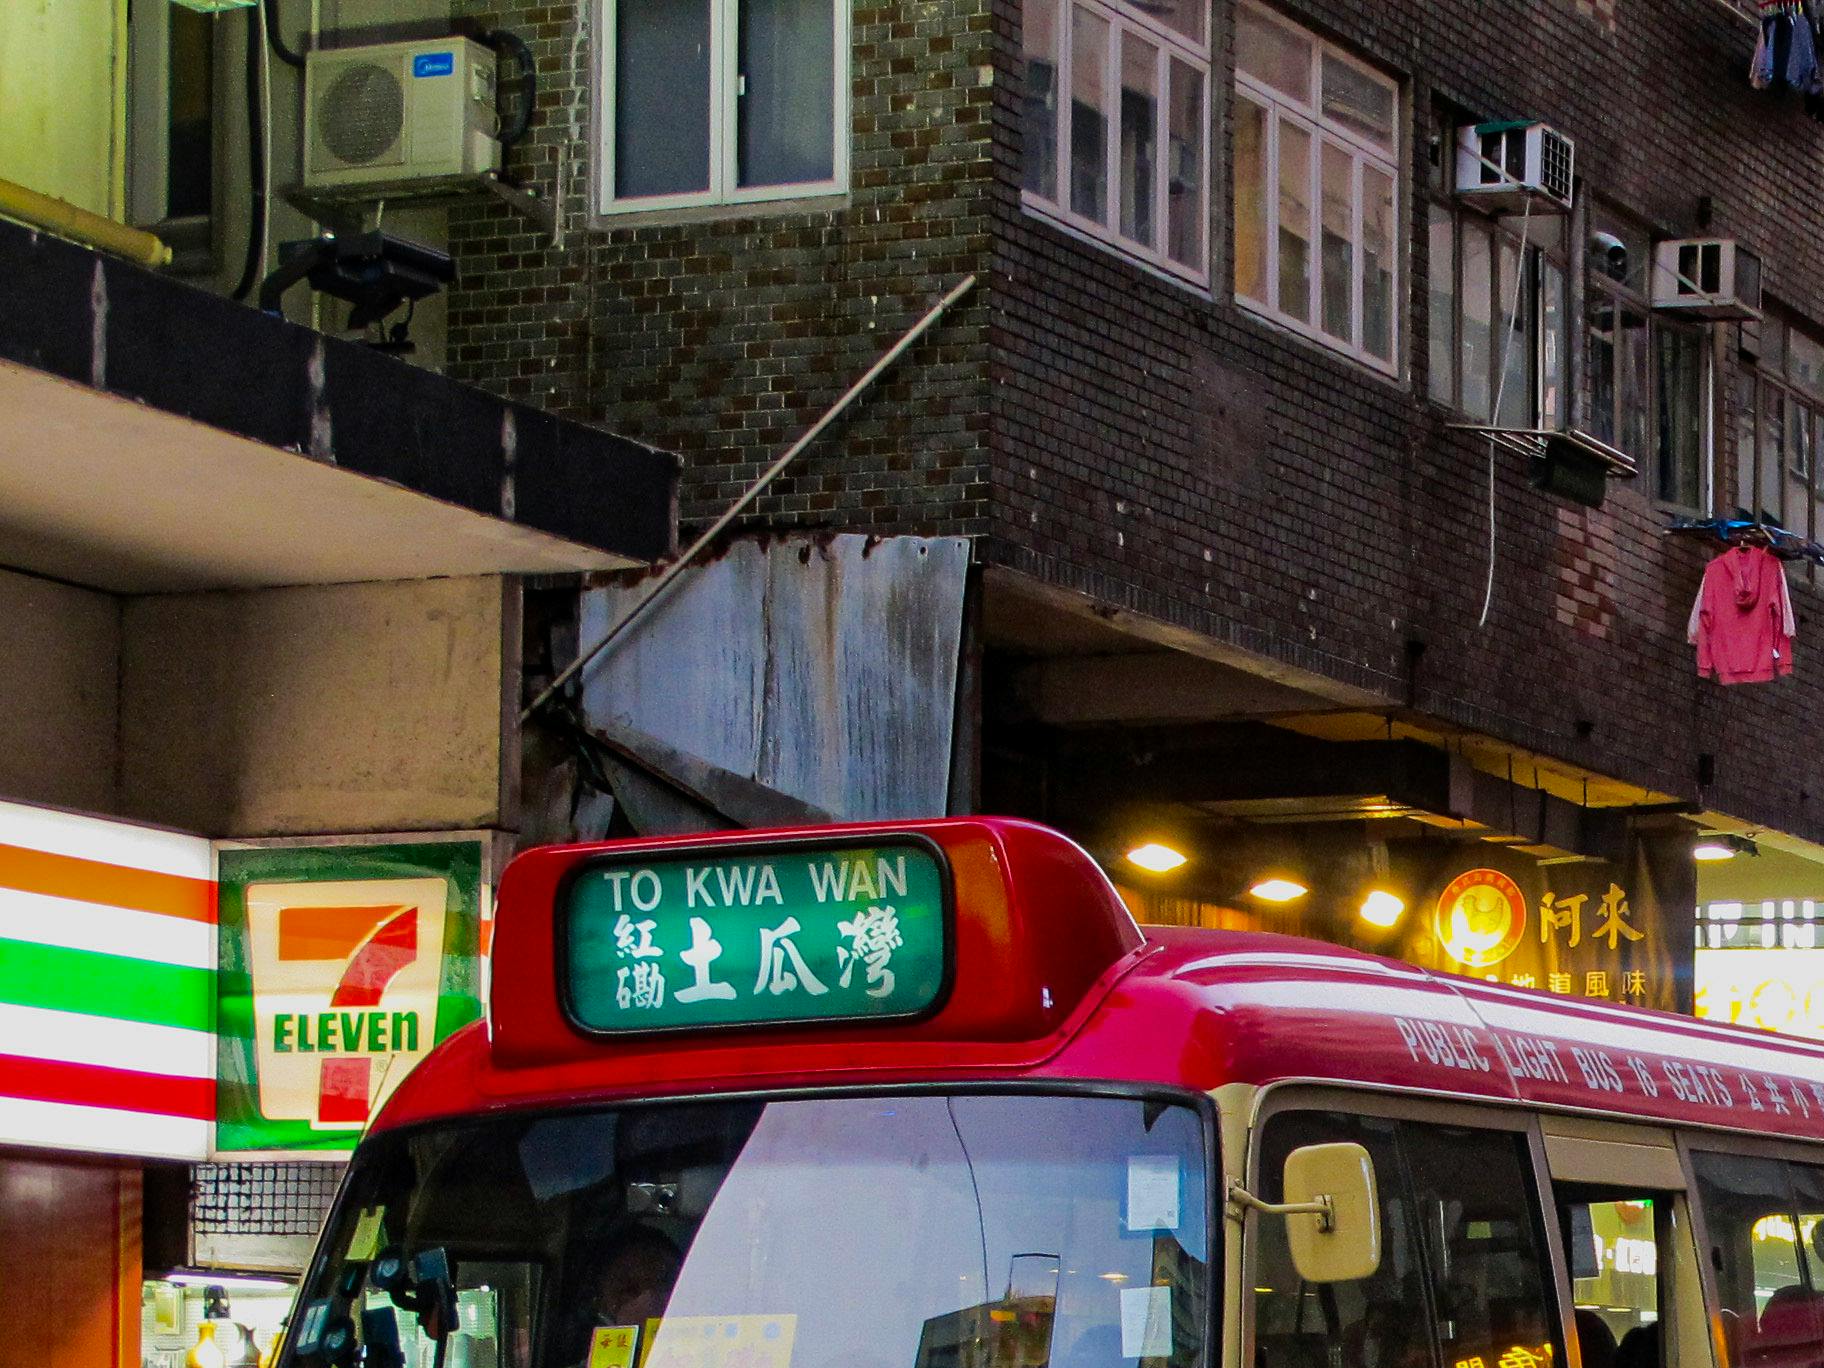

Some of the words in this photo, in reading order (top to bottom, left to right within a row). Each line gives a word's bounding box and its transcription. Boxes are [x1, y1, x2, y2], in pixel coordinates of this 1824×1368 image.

[604, 869, 663, 912] TO
[686, 864, 784, 908] KWA
[808, 856, 908, 903] WAN
[613, 913, 665, 1010] 紅磡
[673, 904, 904, 1004] 土瓜灣
[1485, 969, 1647, 997] 地道風味
[278, 904, 419, 1123] 7
[1394, 1016, 1490, 1073] PUBLIC
[1506, 1034, 1570, 1085] LIGHT
[1571, 1046, 1624, 1094] BUS
[1626, 1055, 1659, 1099] 16
[1661, 1060, 1734, 1108] SEATS
